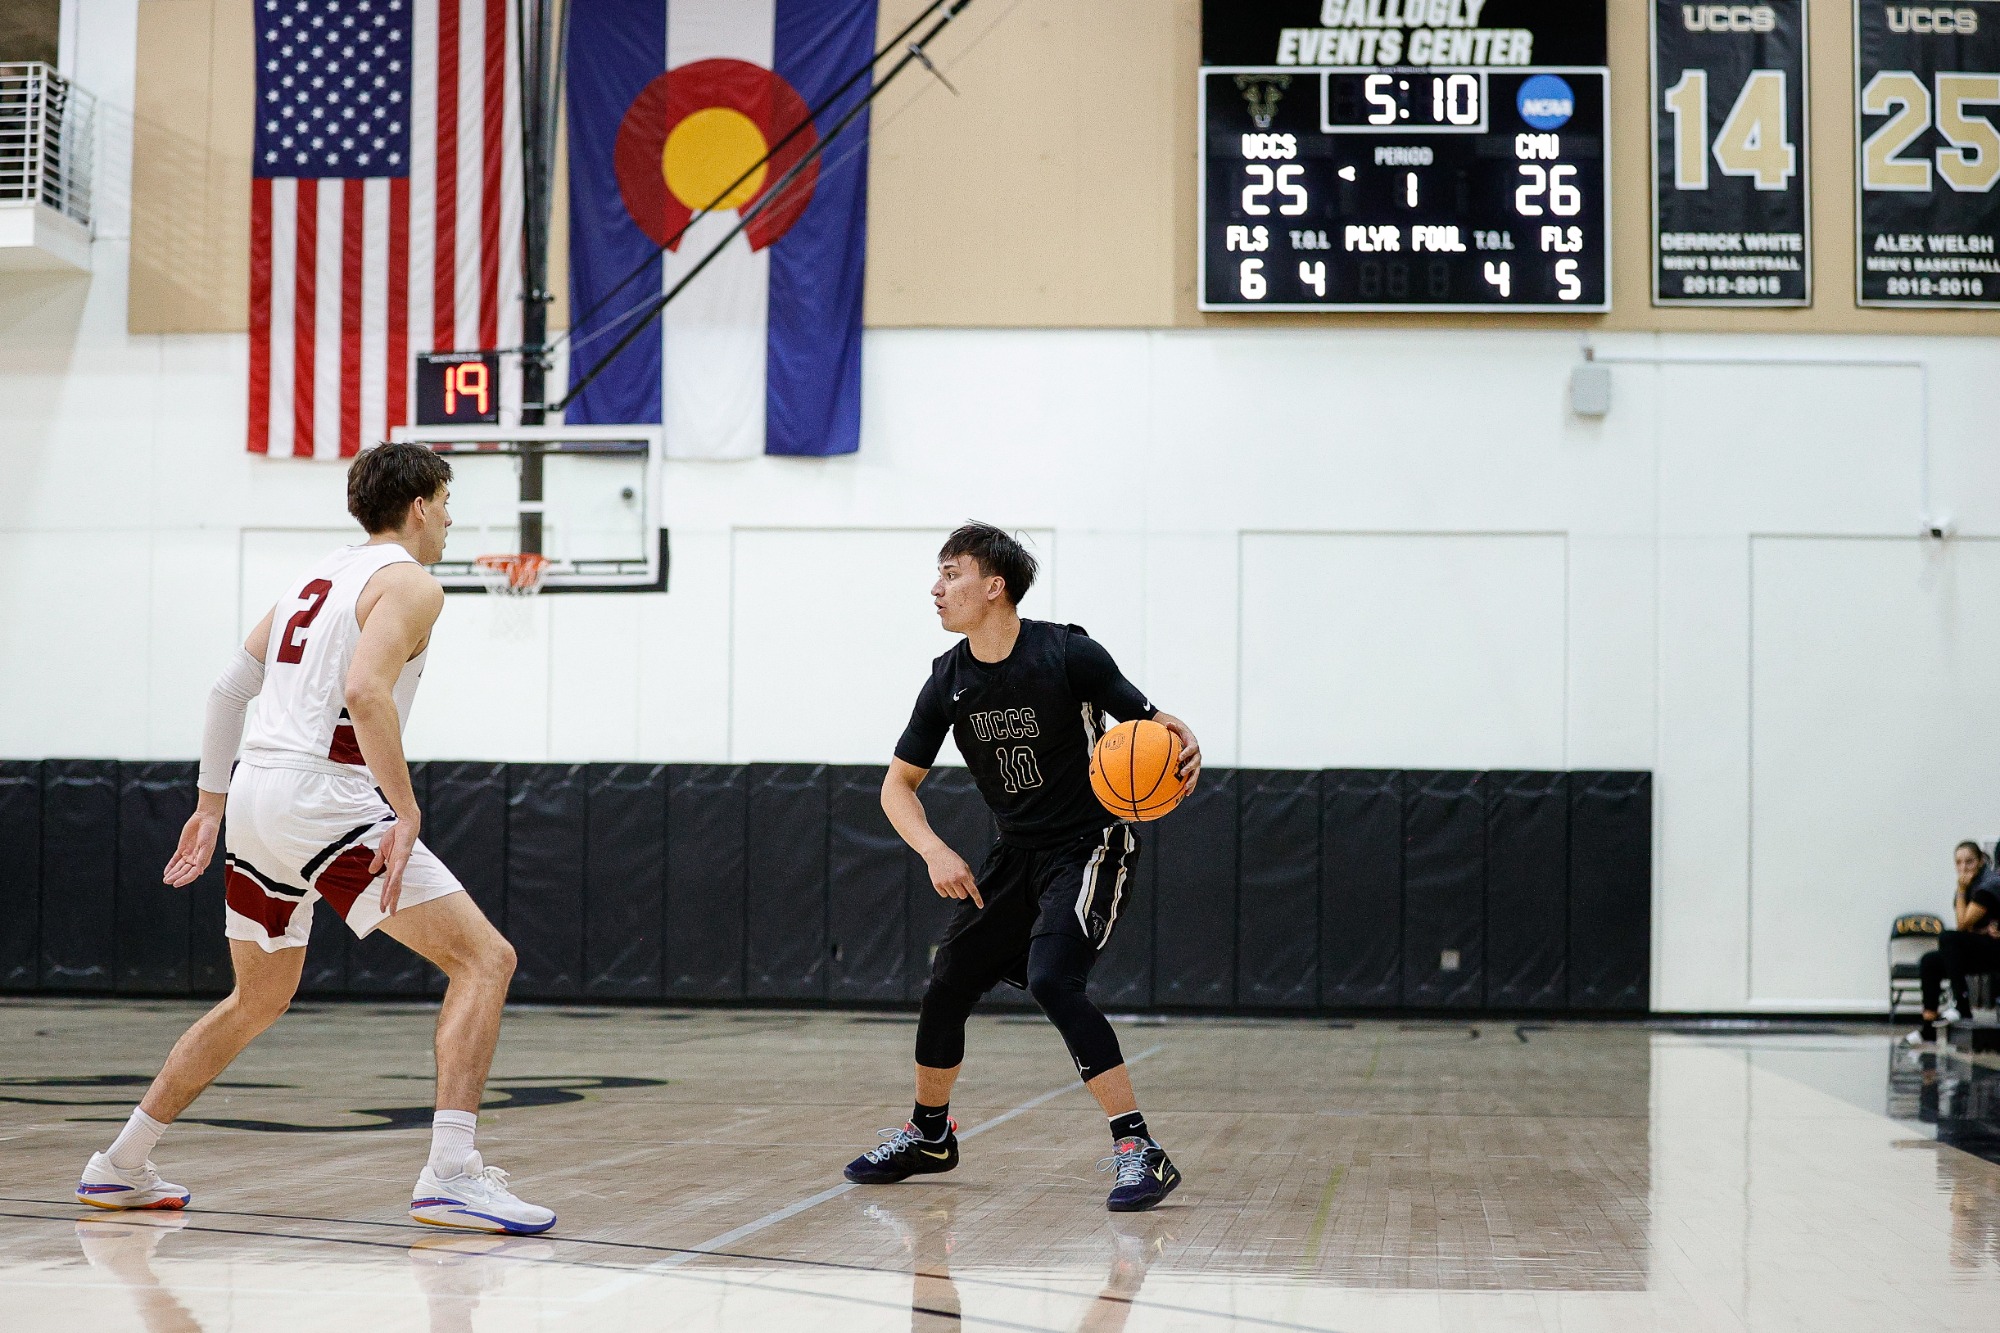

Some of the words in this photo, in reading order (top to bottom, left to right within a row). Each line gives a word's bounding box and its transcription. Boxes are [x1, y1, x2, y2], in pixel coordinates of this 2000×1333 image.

[1320, 0, 1486, 28] GALLOGLY
[1683, 5, 1776, 32] UCCS
[1886, 6, 1978, 33] UCCS
[1276, 28, 1404, 65] EVENTS
[1407, 28, 1534, 65] CENTER
[1242, 133, 1297, 159] UCCS
[1515, 133, 1560, 159] CMU
[1664, 69, 1796, 191] 14
[1862, 70, 2000, 192] 25
[1374, 146, 1434, 166] PERIOD
[1242, 164, 1308, 216] 25
[1406, 172, 1418, 208] 1
[1515, 164, 1581, 216] 26
[1226, 225, 1269, 252] FLS
[1345, 225, 1400, 252] PLYR
[1412, 225, 1467, 252] FOUL
[1541, 225, 1583, 252] FLS
[1661, 232, 1742, 251] DERRICK
[1743, 232, 1803, 252] WHITE
[1873, 233, 1925, 253] ALEX
[1927, 234, 1994, 253] WELSH
[1240, 258, 1267, 300] 6
[1299, 260, 1326, 297] 4
[1484, 261, 1510, 298] 4
[1555, 258, 1581, 300] 5
[1662, 255, 1709, 271] MEN'S
[1709, 255, 1801, 272] BASKETBALL
[1866, 256, 1912, 272] MEN'S
[1913, 257, 2000, 273] BASKETBALL
[444, 361, 490, 416] 19
[276, 578, 334, 664] 2
[969, 707, 1040, 742] UCCS
[996, 745, 1044, 794] 10
